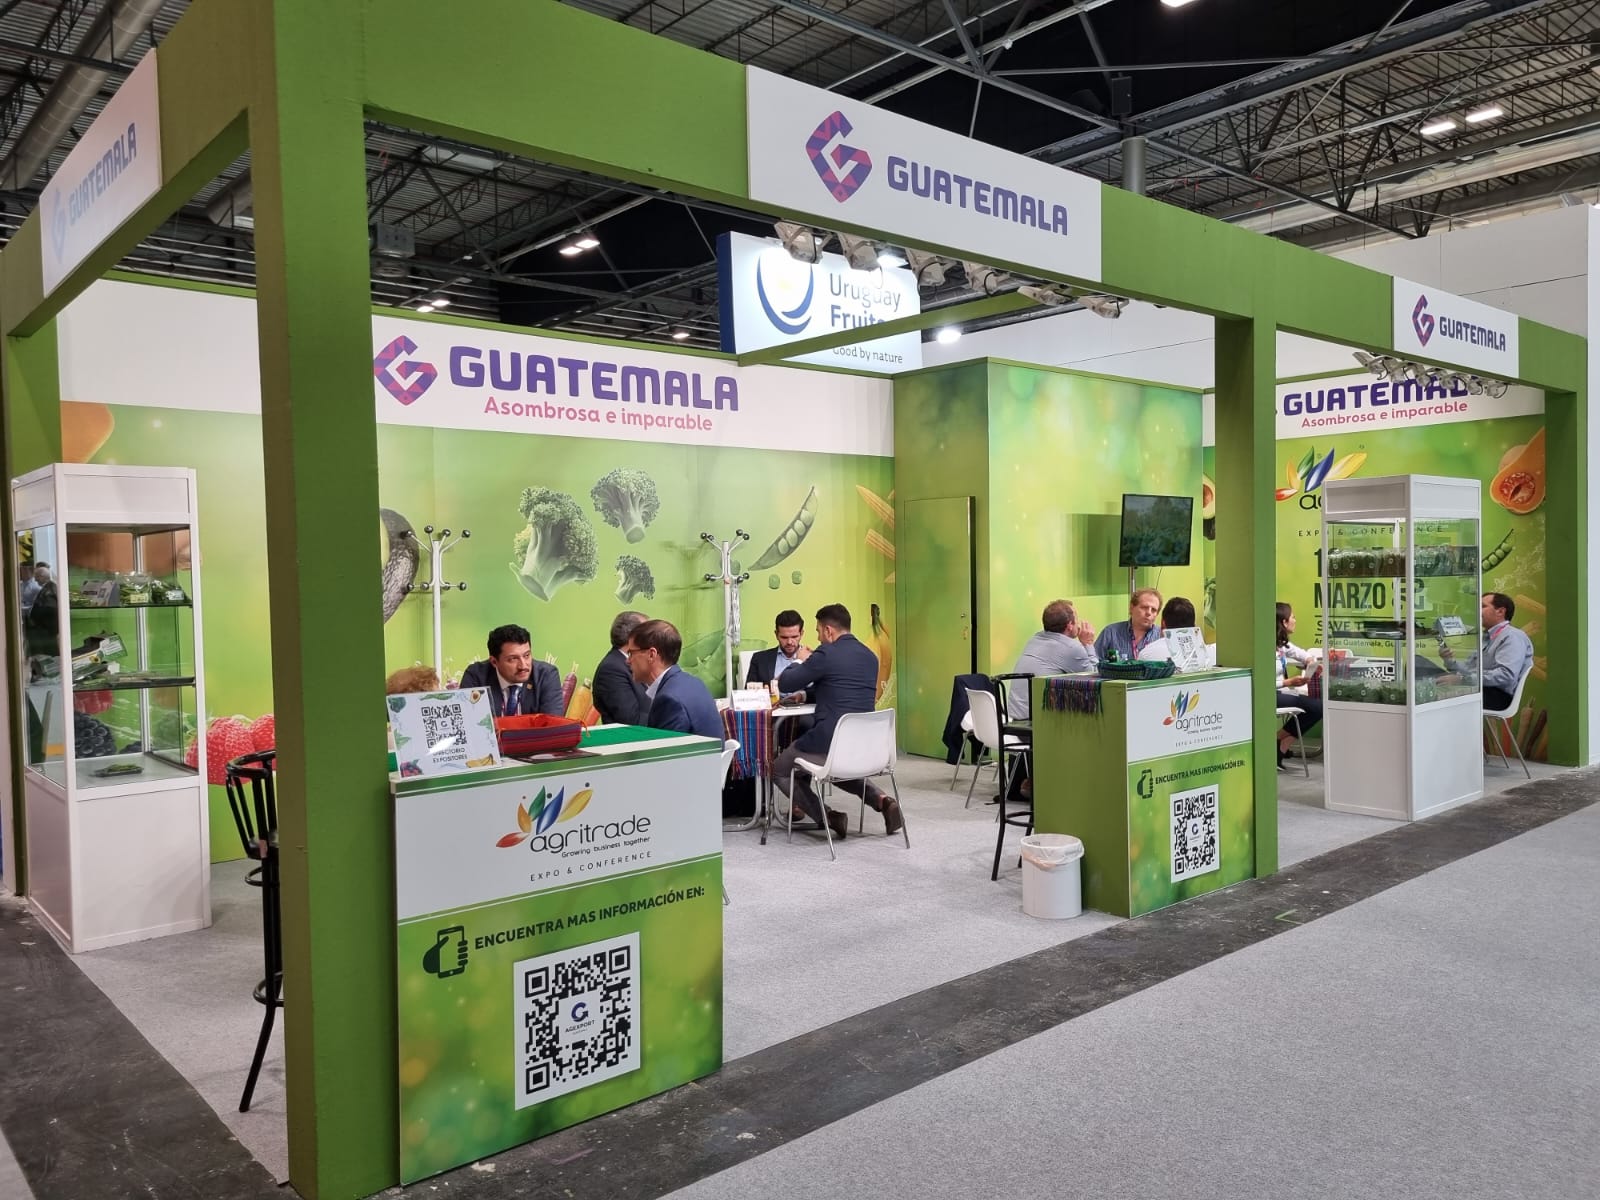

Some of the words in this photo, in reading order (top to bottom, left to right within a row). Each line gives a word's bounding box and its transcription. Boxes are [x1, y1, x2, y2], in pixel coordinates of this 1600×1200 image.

[69, 122, 137, 226] GUATEMALA
[887, 155, 1068, 236] GUATEMALA
[829, 273, 901, 312] Uruguay
[1439, 316, 1506, 352] GUATEMALA
[859, 347, 871, 362] by
[873, 351, 903, 364] nature
[449, 346, 739, 411] GUATEMALA
[1282, 375, 1479, 416] GUATEMAL
[484, 396, 601, 423] Asombrosa
[606, 409, 617, 424] e
[621, 407, 713, 431] imparable
[1301, 410, 1376, 428] Asombrosa
[1380, 411, 1388, 420] e
[1391, 402, 1468, 420] imparable
[1298, 529, 1329, 537] EXP
[1314, 582, 1386, 609] MARZO
[1175, 712, 1223, 732] agritrade
[1155, 771, 1189, 784] ENCUENTRA
[530, 814, 652, 854] agritrade
[562, 847, 591, 858] Growing
[594, 840, 621, 852] business
[623, 836, 651, 847] together
[530, 869, 560, 881] EXPO
[580, 851, 652, 871] CONFERENCE
[474, 918, 564, 950] ENCUENTRA
[567, 911, 596, 928] MAS
[599, 890, 684, 920] INFORMACIÓN
[686, 886, 705, 899] EN:
